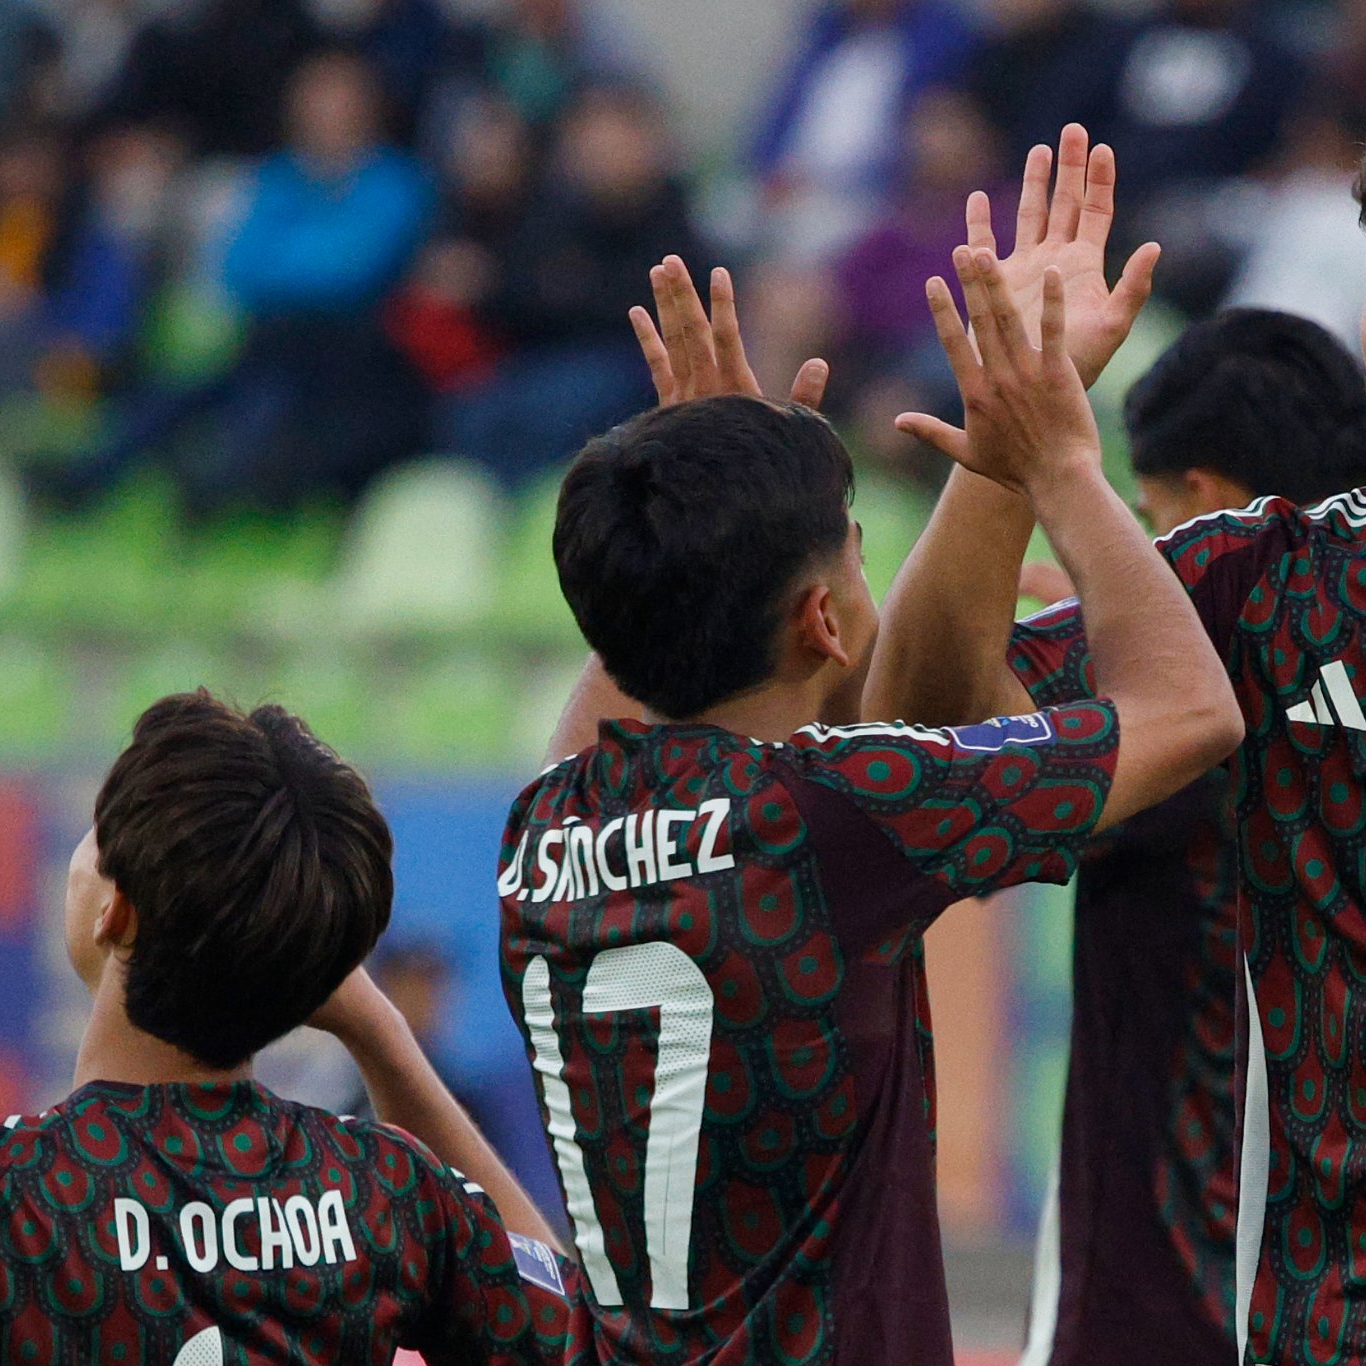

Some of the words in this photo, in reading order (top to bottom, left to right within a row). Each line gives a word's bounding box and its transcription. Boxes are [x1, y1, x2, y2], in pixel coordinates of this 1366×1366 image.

[114, 1197, 169, 1271] D.
[180, 1190, 357, 1273] OCHOA
[521, 941, 715, 1310] 17
